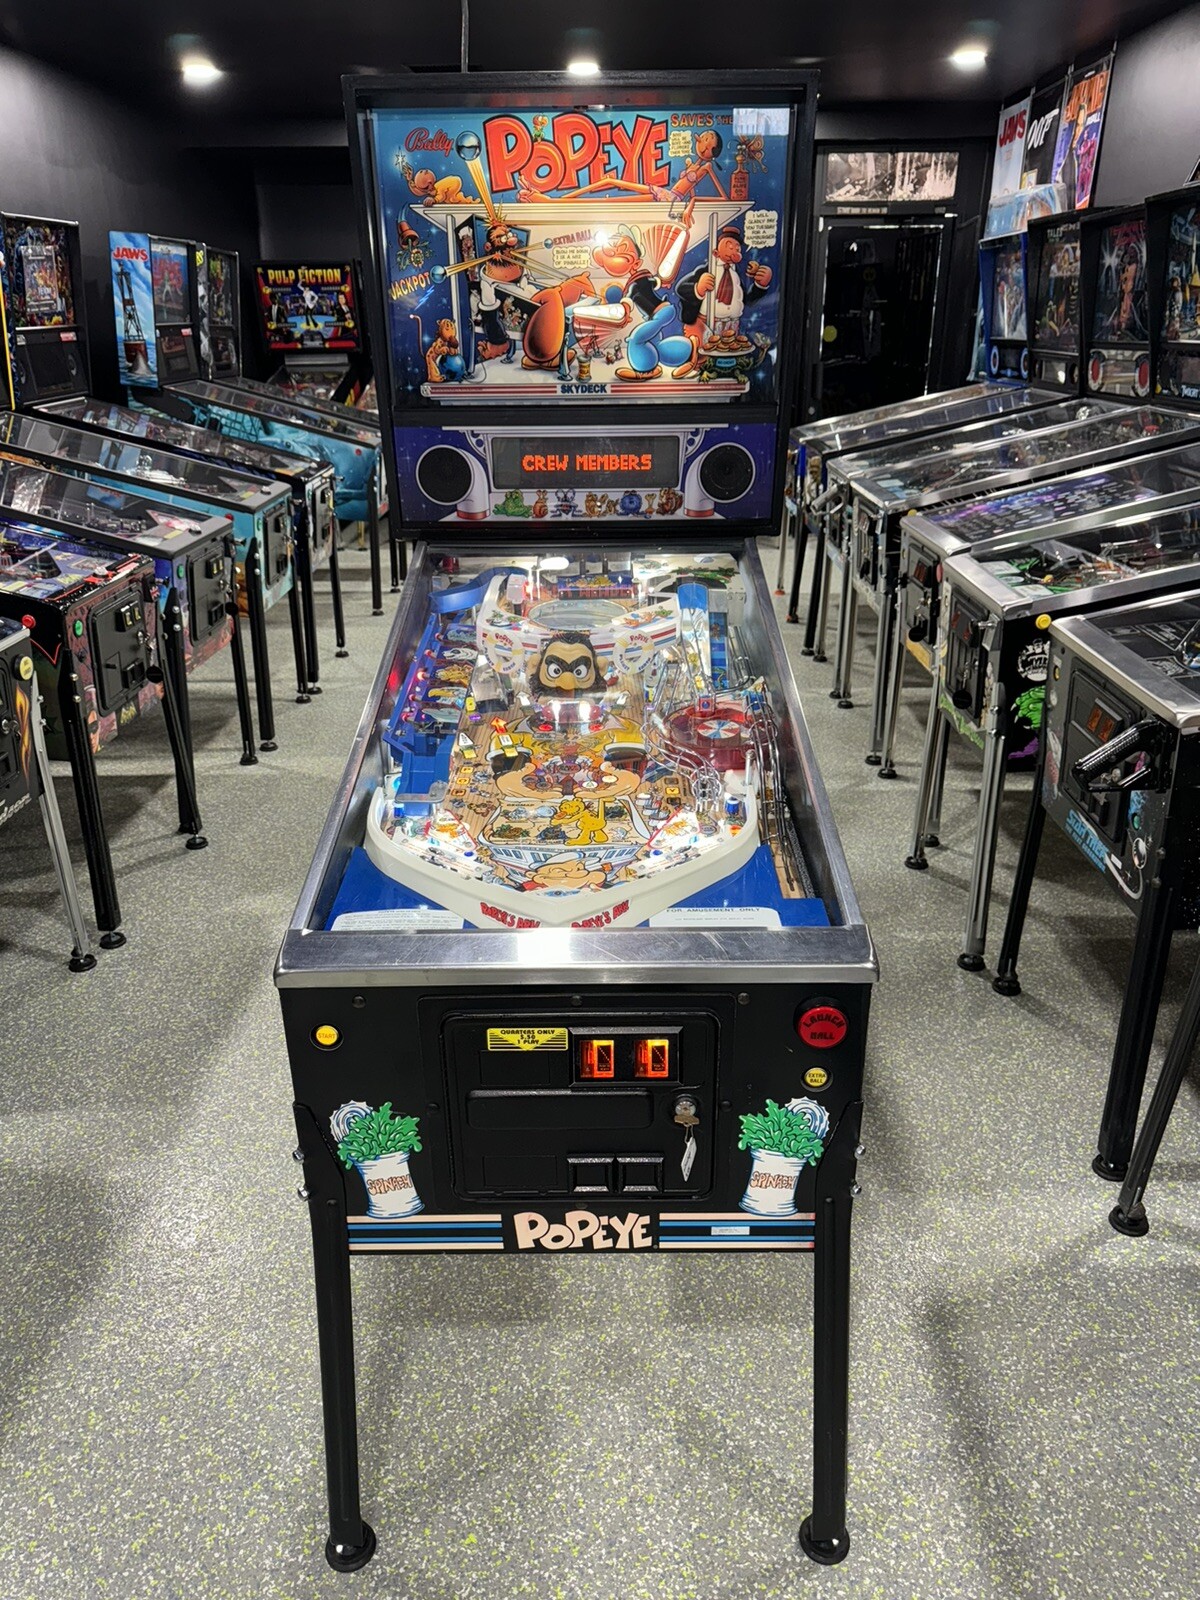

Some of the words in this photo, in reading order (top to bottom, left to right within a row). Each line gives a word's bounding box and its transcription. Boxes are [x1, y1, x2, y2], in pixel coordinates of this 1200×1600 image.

[671, 113, 714, 127] SAVES
[999, 109, 1027, 147] JAWS
[405, 127, 454, 157] Bally
[483, 113, 671, 194] POPEYE
[553, 234, 576, 245] EXTRA
[576, 229, 592, 242] BALL
[112, 247, 148, 260] JAWS
[267, 269, 296, 285] PULP
[298, 268, 341, 285] FICTION
[388, 271, 431, 300] JACKPOT
[560, 384, 607, 394] SKYDECK
[522, 454, 569, 472] CREW
[575, 454, 652, 471] MEMBERS
[1066, 809, 1088, 838] STAR
[1086, 828, 1110, 861] TREK
[612, 900, 630, 920] ARK
[803, 1013, 845, 1028] LAUNCH
[810, 1031, 835, 1040] BALL
[367, 1174, 413, 1196] SPINACH
[749, 1170, 798, 1189] SPINACH
[513, 1210, 652, 1249] POPEYE
